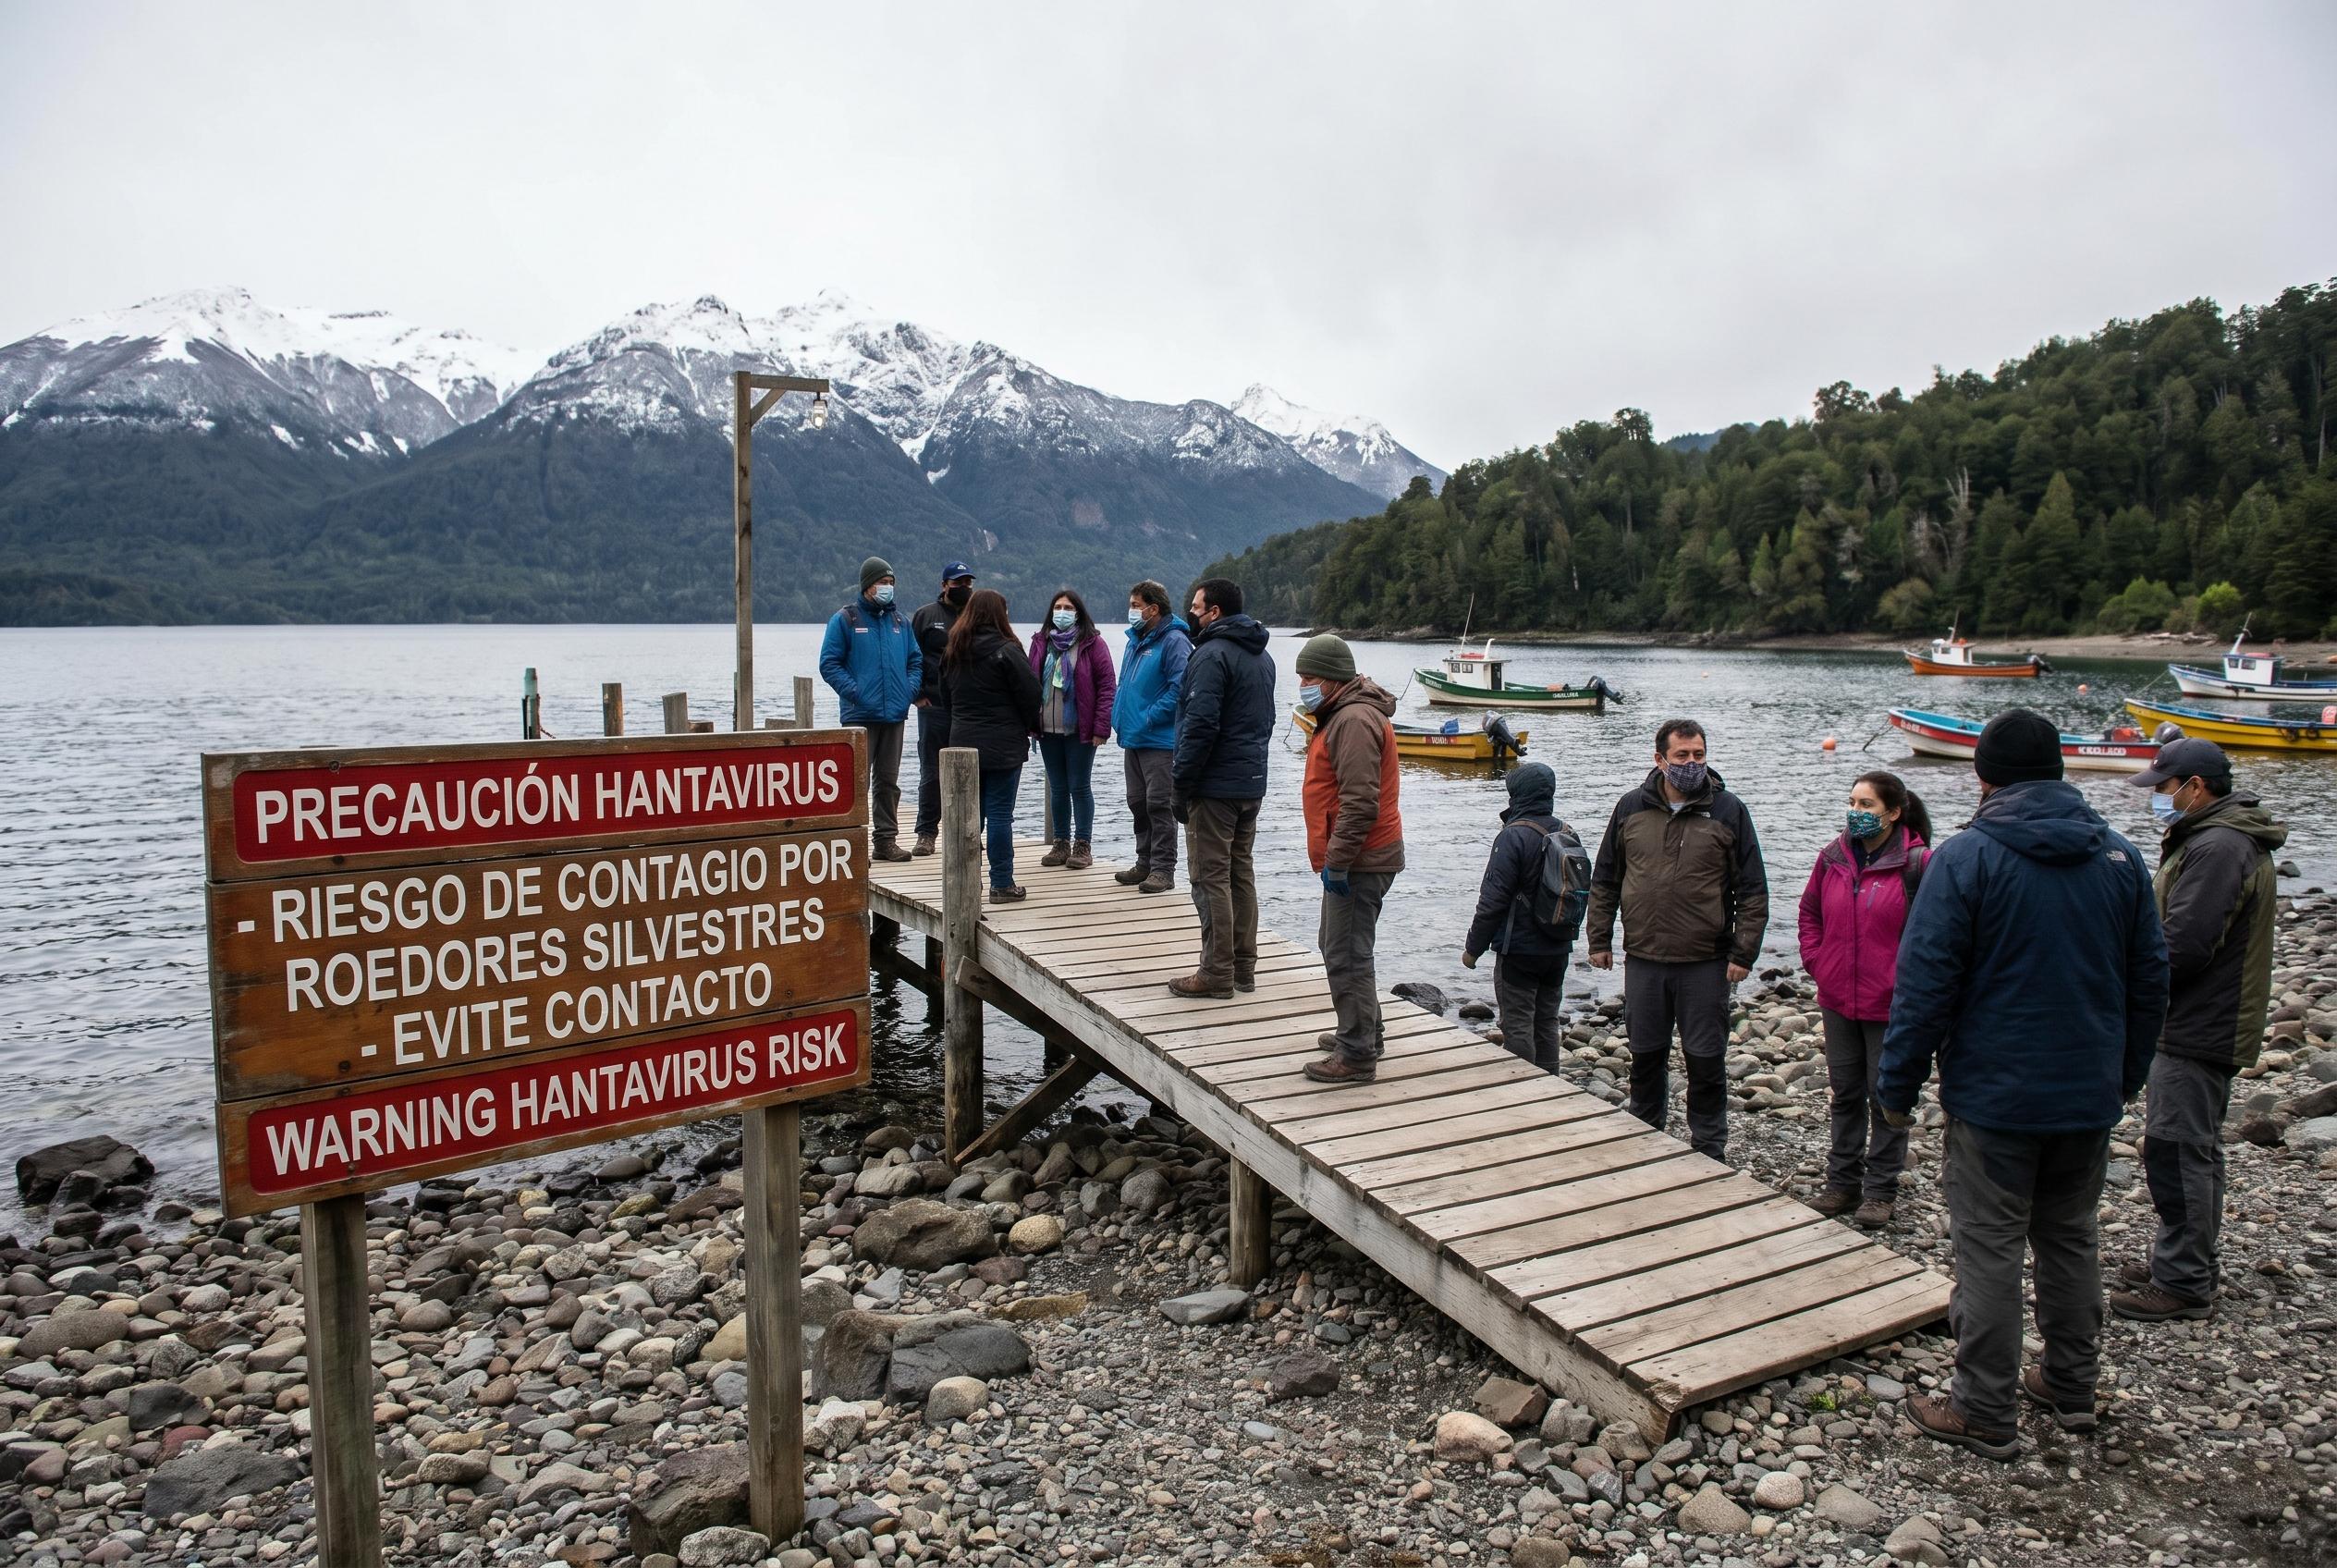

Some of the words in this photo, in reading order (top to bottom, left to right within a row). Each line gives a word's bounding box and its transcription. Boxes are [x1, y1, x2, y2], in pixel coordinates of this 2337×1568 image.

[255, 762, 580, 844] PRECAUCIÓN
[595, 759, 839, 819] HANTAVIRUS
[272, 874, 466, 943] RIESGO
[483, 866, 543, 920] DE
[557, 846, 767, 912] CONTAGIO
[779, 839, 853, 887] POR
[286, 927, 568, 1012] ROEDORES
[582, 897, 825, 972] SILVESTRES
[393, 996, 531, 1066] EVITE
[545, 962, 772, 1039] CONTACTO
[265, 1087, 496, 1176] WARNING
[511, 1040, 756, 1130] HANTAVIRUS
[768, 1023, 847, 1078] RISK
